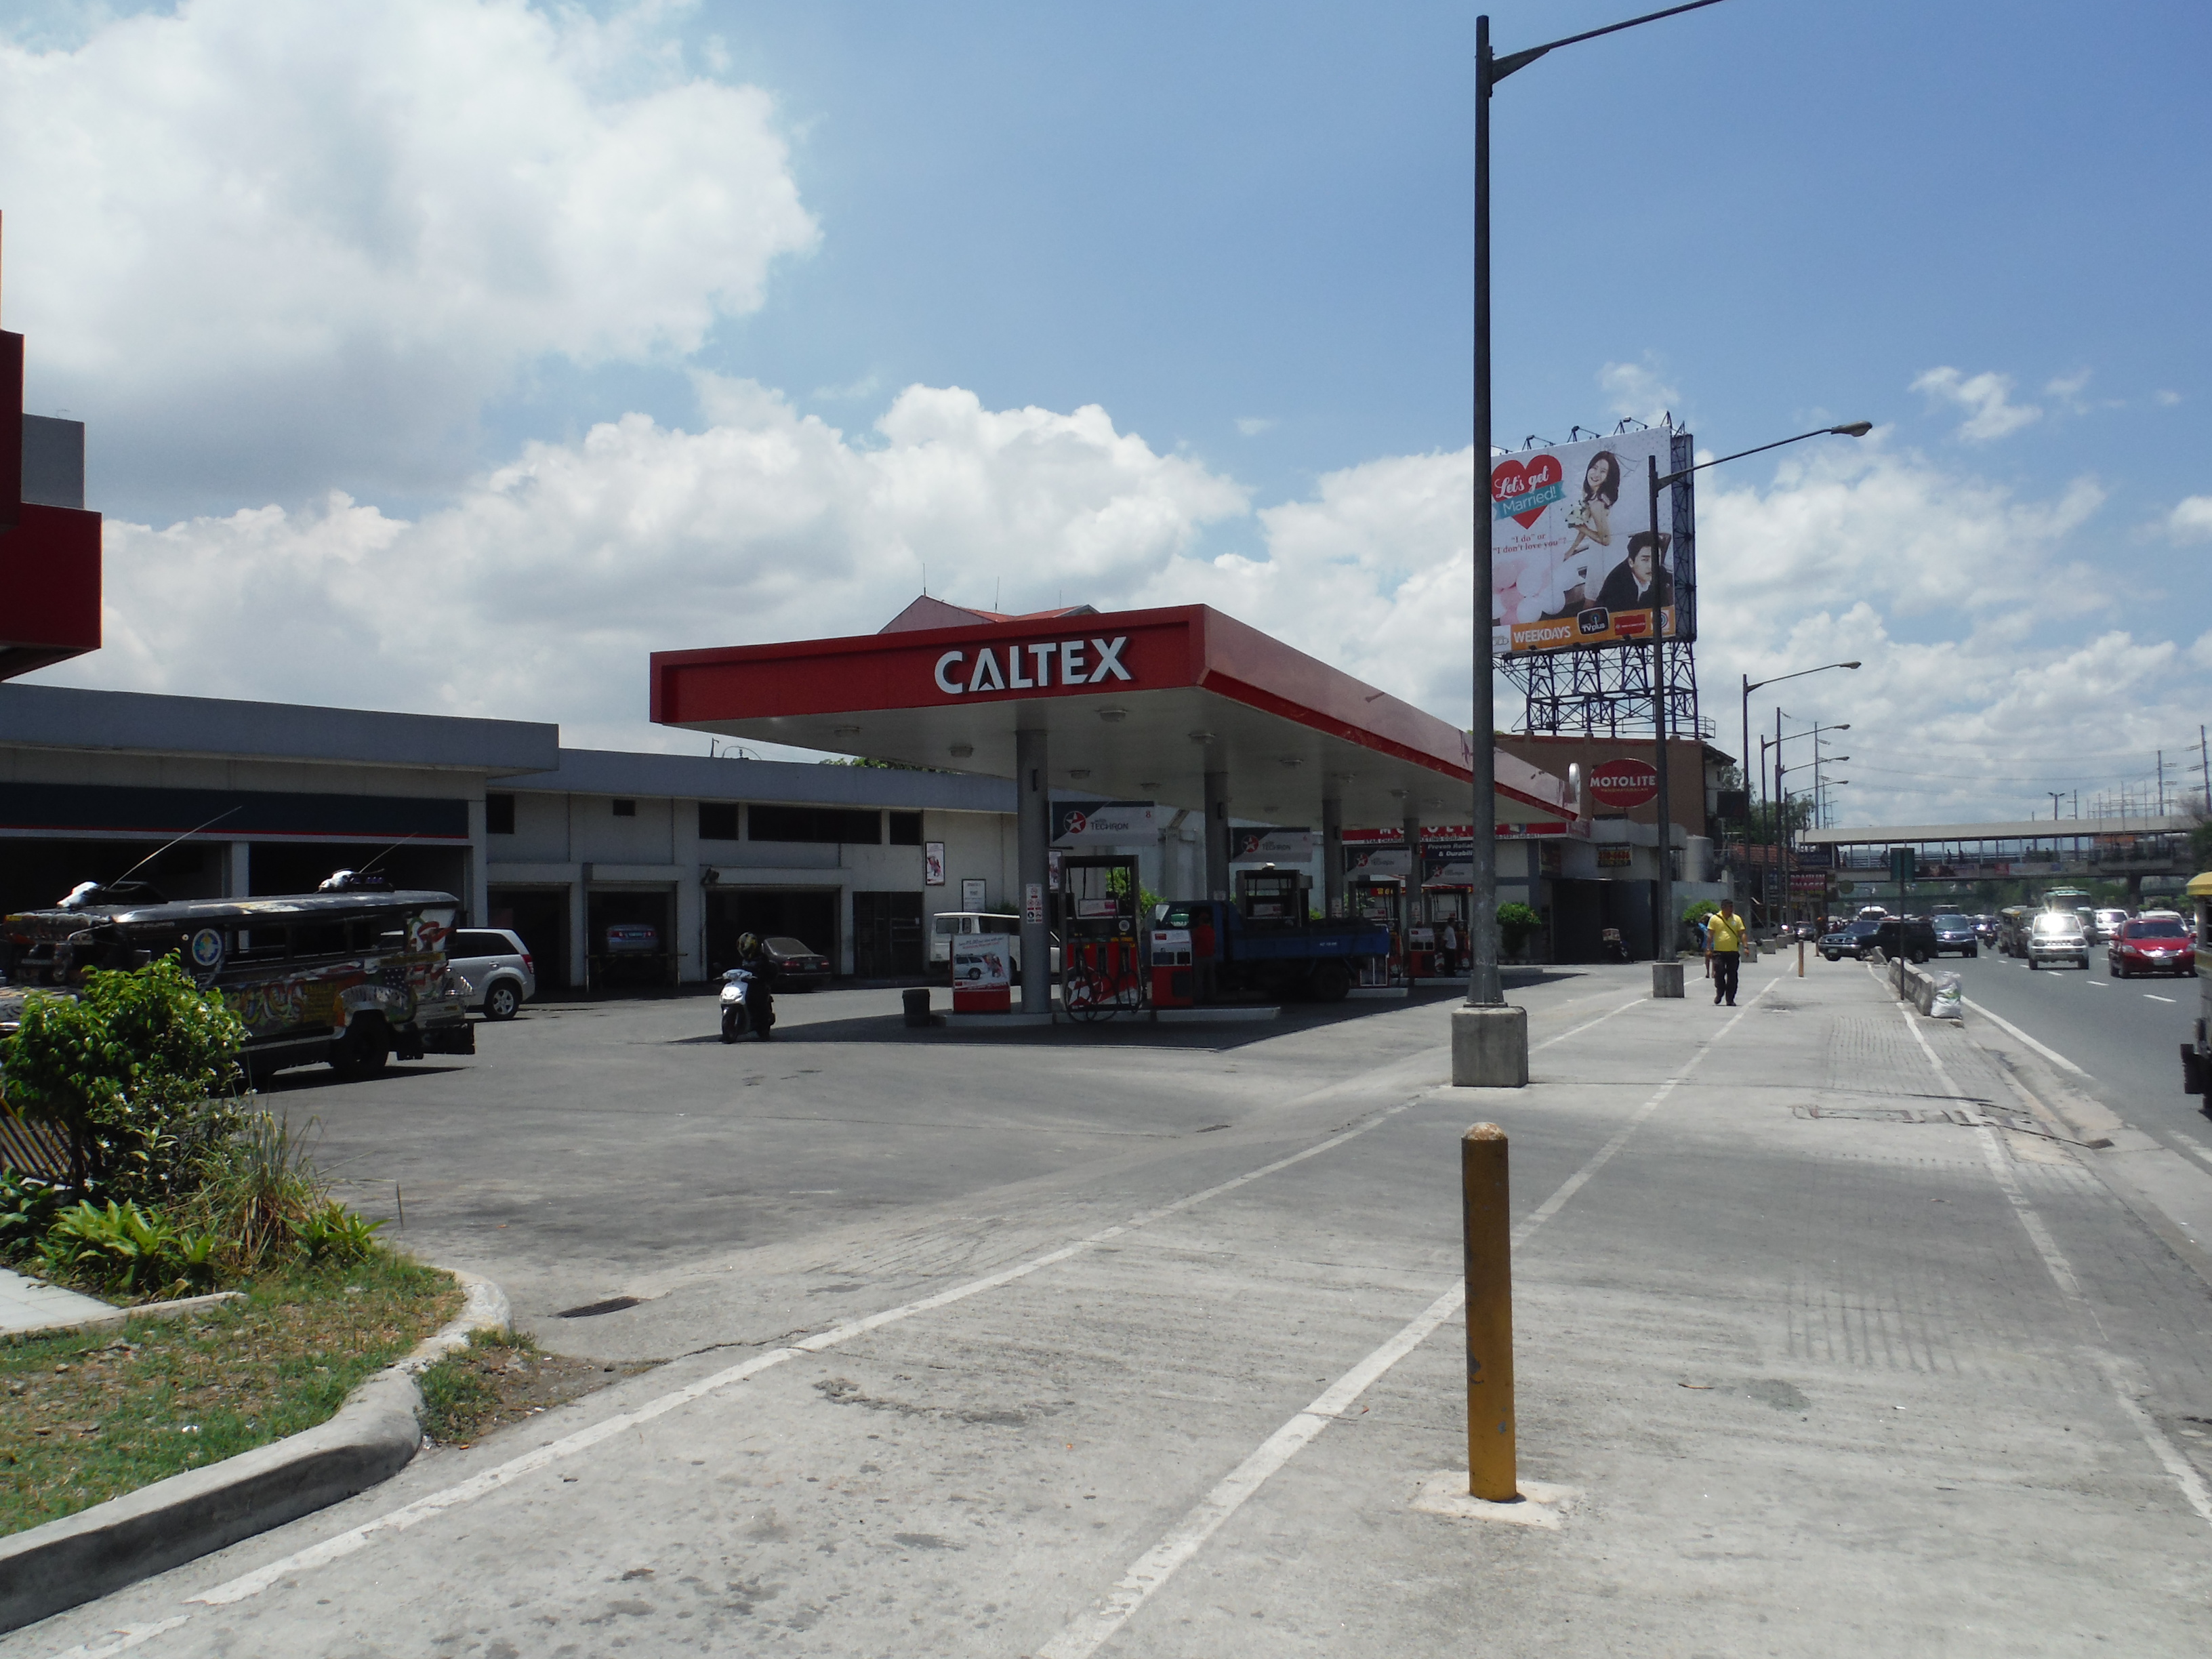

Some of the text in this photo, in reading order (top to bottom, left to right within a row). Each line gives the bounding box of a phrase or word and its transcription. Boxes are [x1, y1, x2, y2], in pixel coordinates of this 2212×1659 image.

[1494, 465, 1549, 499] Let's get
[1502, 485, 1557, 515] Married!
[1503, 544, 1523, 553] don't
[1525, 541, 1542, 550] love
[1513, 625, 1571, 644] WEEKDAYS
[935, 636, 1132, 695] CALTEX
[1589, 775, 1656, 787] MOTOLITE
[1090, 821, 1129, 831] TECHRON
